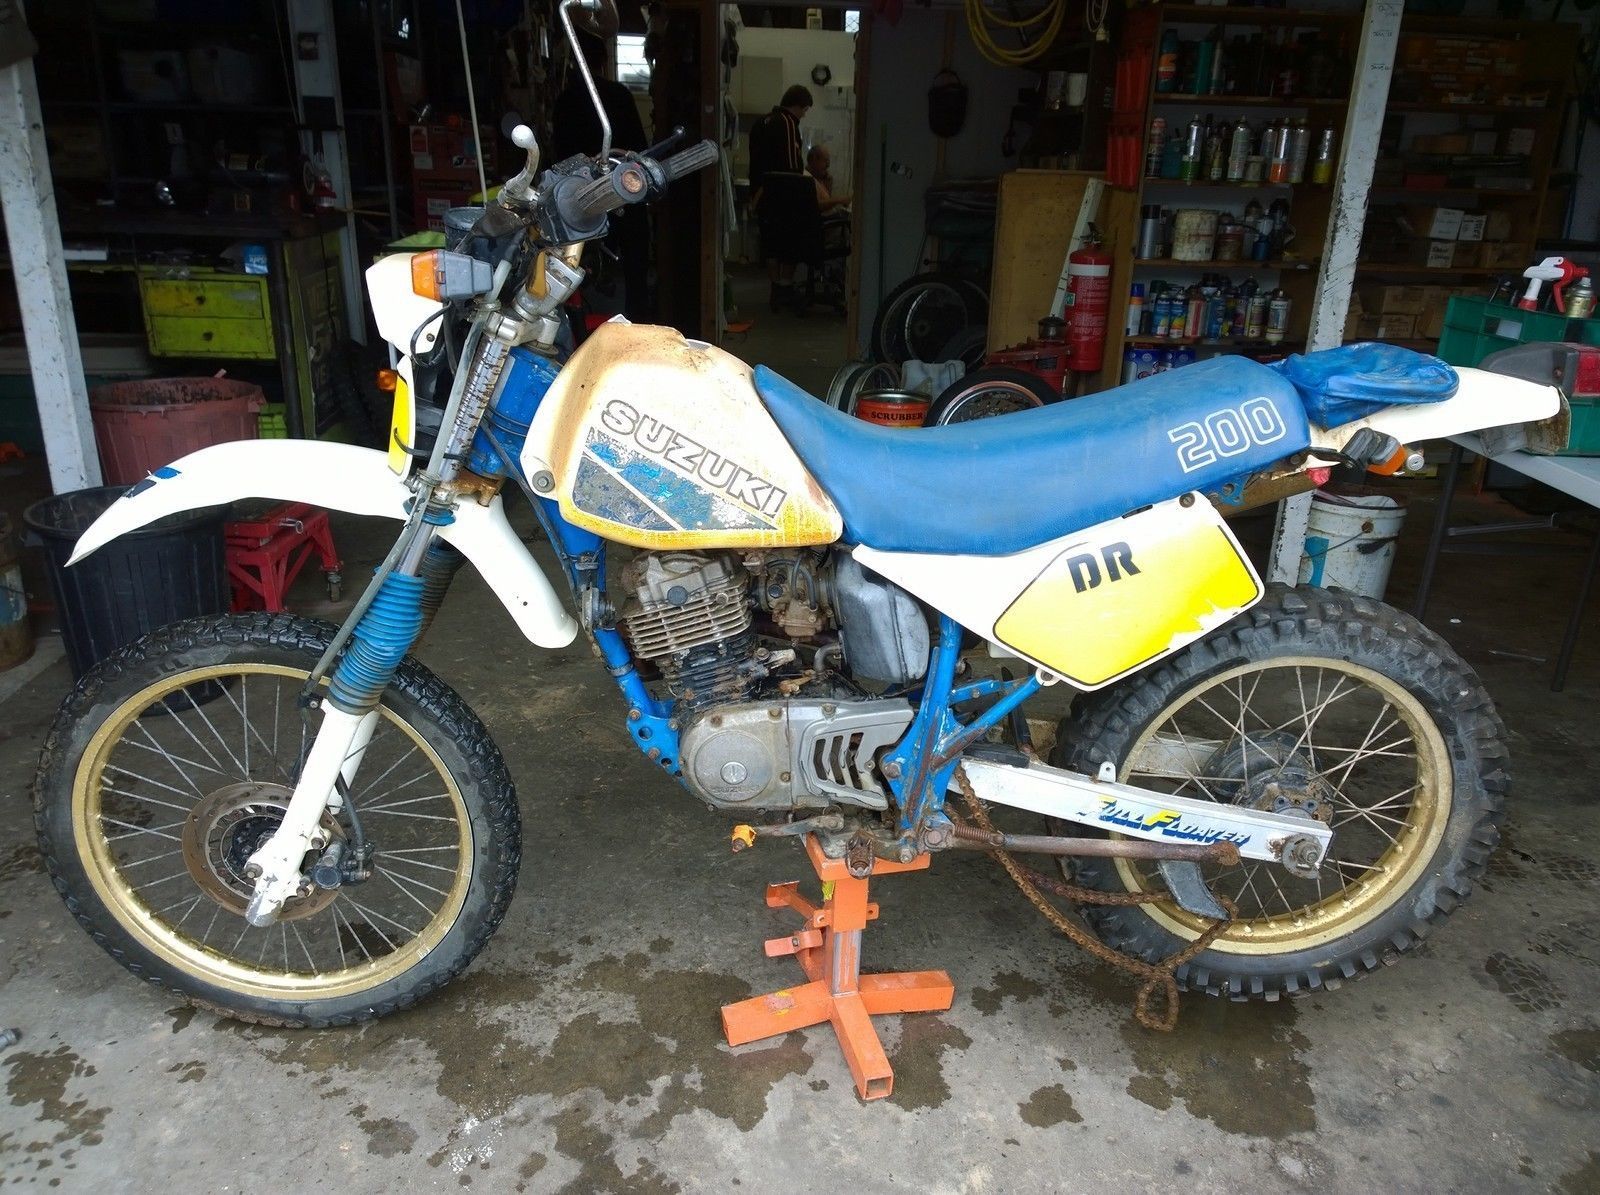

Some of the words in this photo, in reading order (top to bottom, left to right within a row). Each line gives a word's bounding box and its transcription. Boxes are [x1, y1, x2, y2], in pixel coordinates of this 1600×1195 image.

[871, 410, 924, 421] SCRUBBER
[1167, 396, 1287, 473] 200
[600, 399, 788, 518] SUZUKI
[1066, 541, 1141, 593] DR
